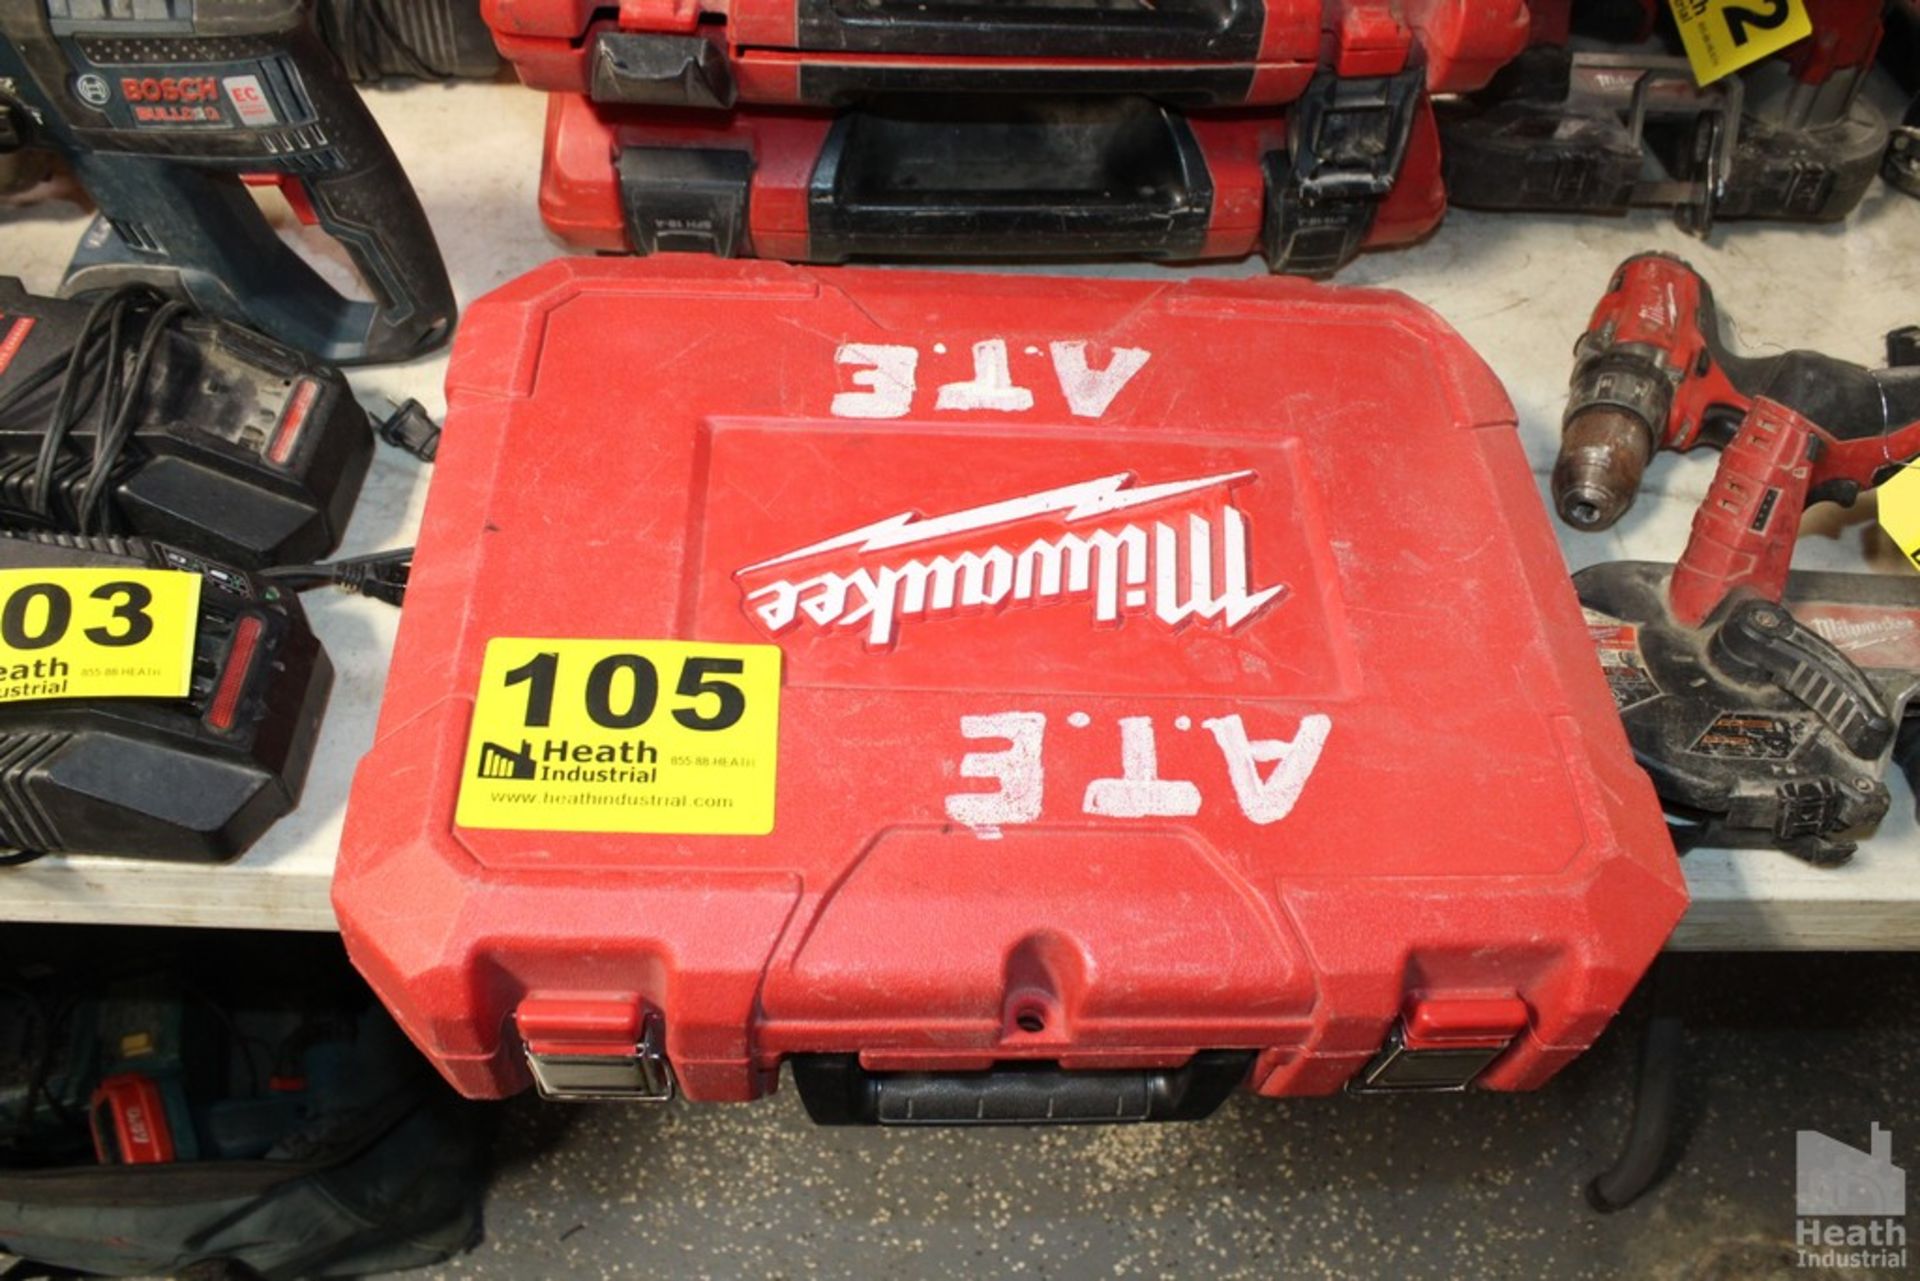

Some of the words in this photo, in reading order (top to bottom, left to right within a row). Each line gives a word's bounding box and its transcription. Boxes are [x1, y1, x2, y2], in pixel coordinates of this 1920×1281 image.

[1722, 0, 1789, 47] 2
[121, 76, 218, 102] BOSCH
[231, 88, 259, 103] EC
[747, 505, 1286, 645] Milwaukee
[504, 652, 746, 731] 105
[543, 740, 657, 763] Heath
[541, 765, 656, 783] Industrial
[490, 791, 734, 808] www.heathindustrial.com
